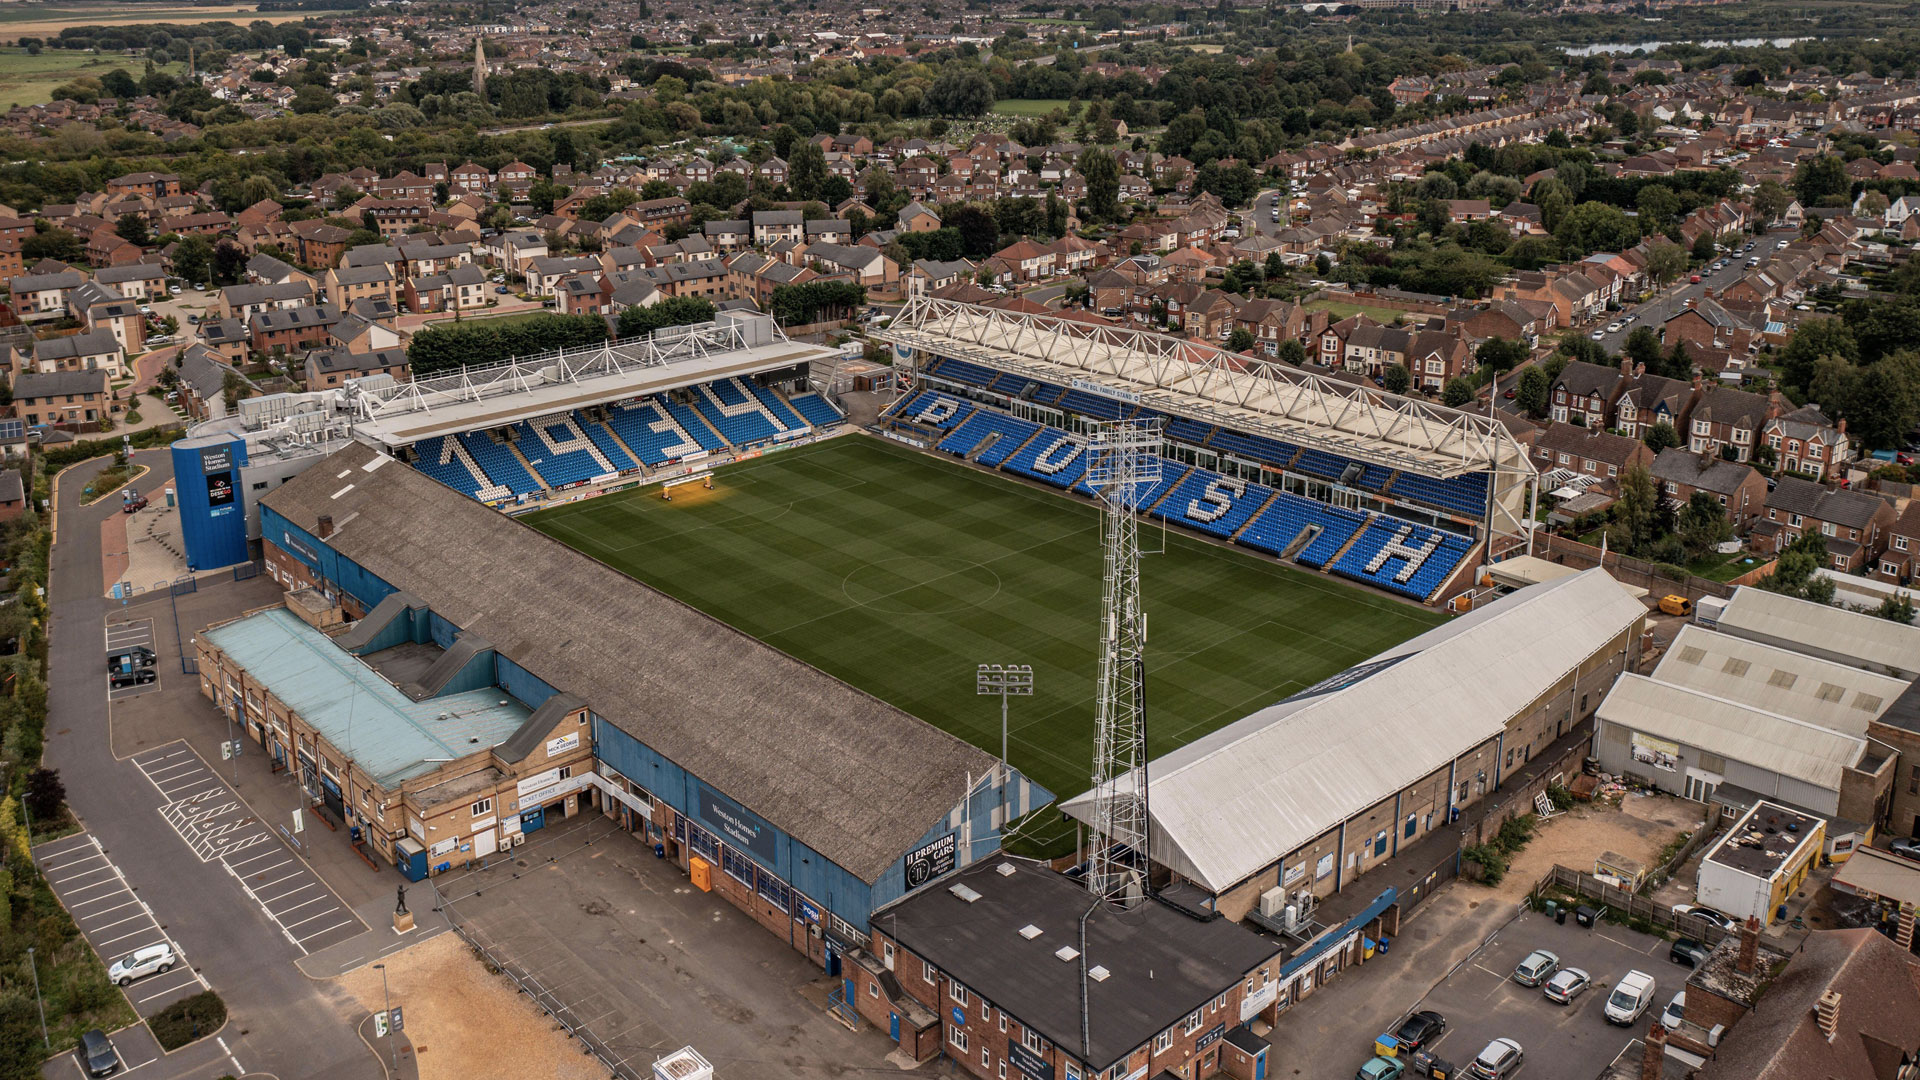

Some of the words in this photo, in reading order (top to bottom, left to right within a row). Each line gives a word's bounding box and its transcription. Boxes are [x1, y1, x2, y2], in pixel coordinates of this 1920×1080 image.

[1080, 382, 1089, 390] THE
[1089, 384, 1099, 392] BGL
[1100, 387, 1116, 396] FAMILY
[1116, 391, 1133, 400] STAND
[203, 453, 226, 461] Weston
[205, 463, 231, 471] Stadium
[210, 489, 232, 498] DESKGO
[548, 744, 560, 753] MICK
[560, 739, 578, 749] GEORGE
[520, 793, 538, 804] TICKET
[538, 787, 556, 798] OFFICE
[712, 803, 735, 824] Weston
[734, 817, 757, 838] Homes
[723, 822, 749, 845] Stadium
[915, 834, 954, 860] PREMIUM
[933, 843, 954, 860] CARS
[803, 904, 819, 920] POSH
